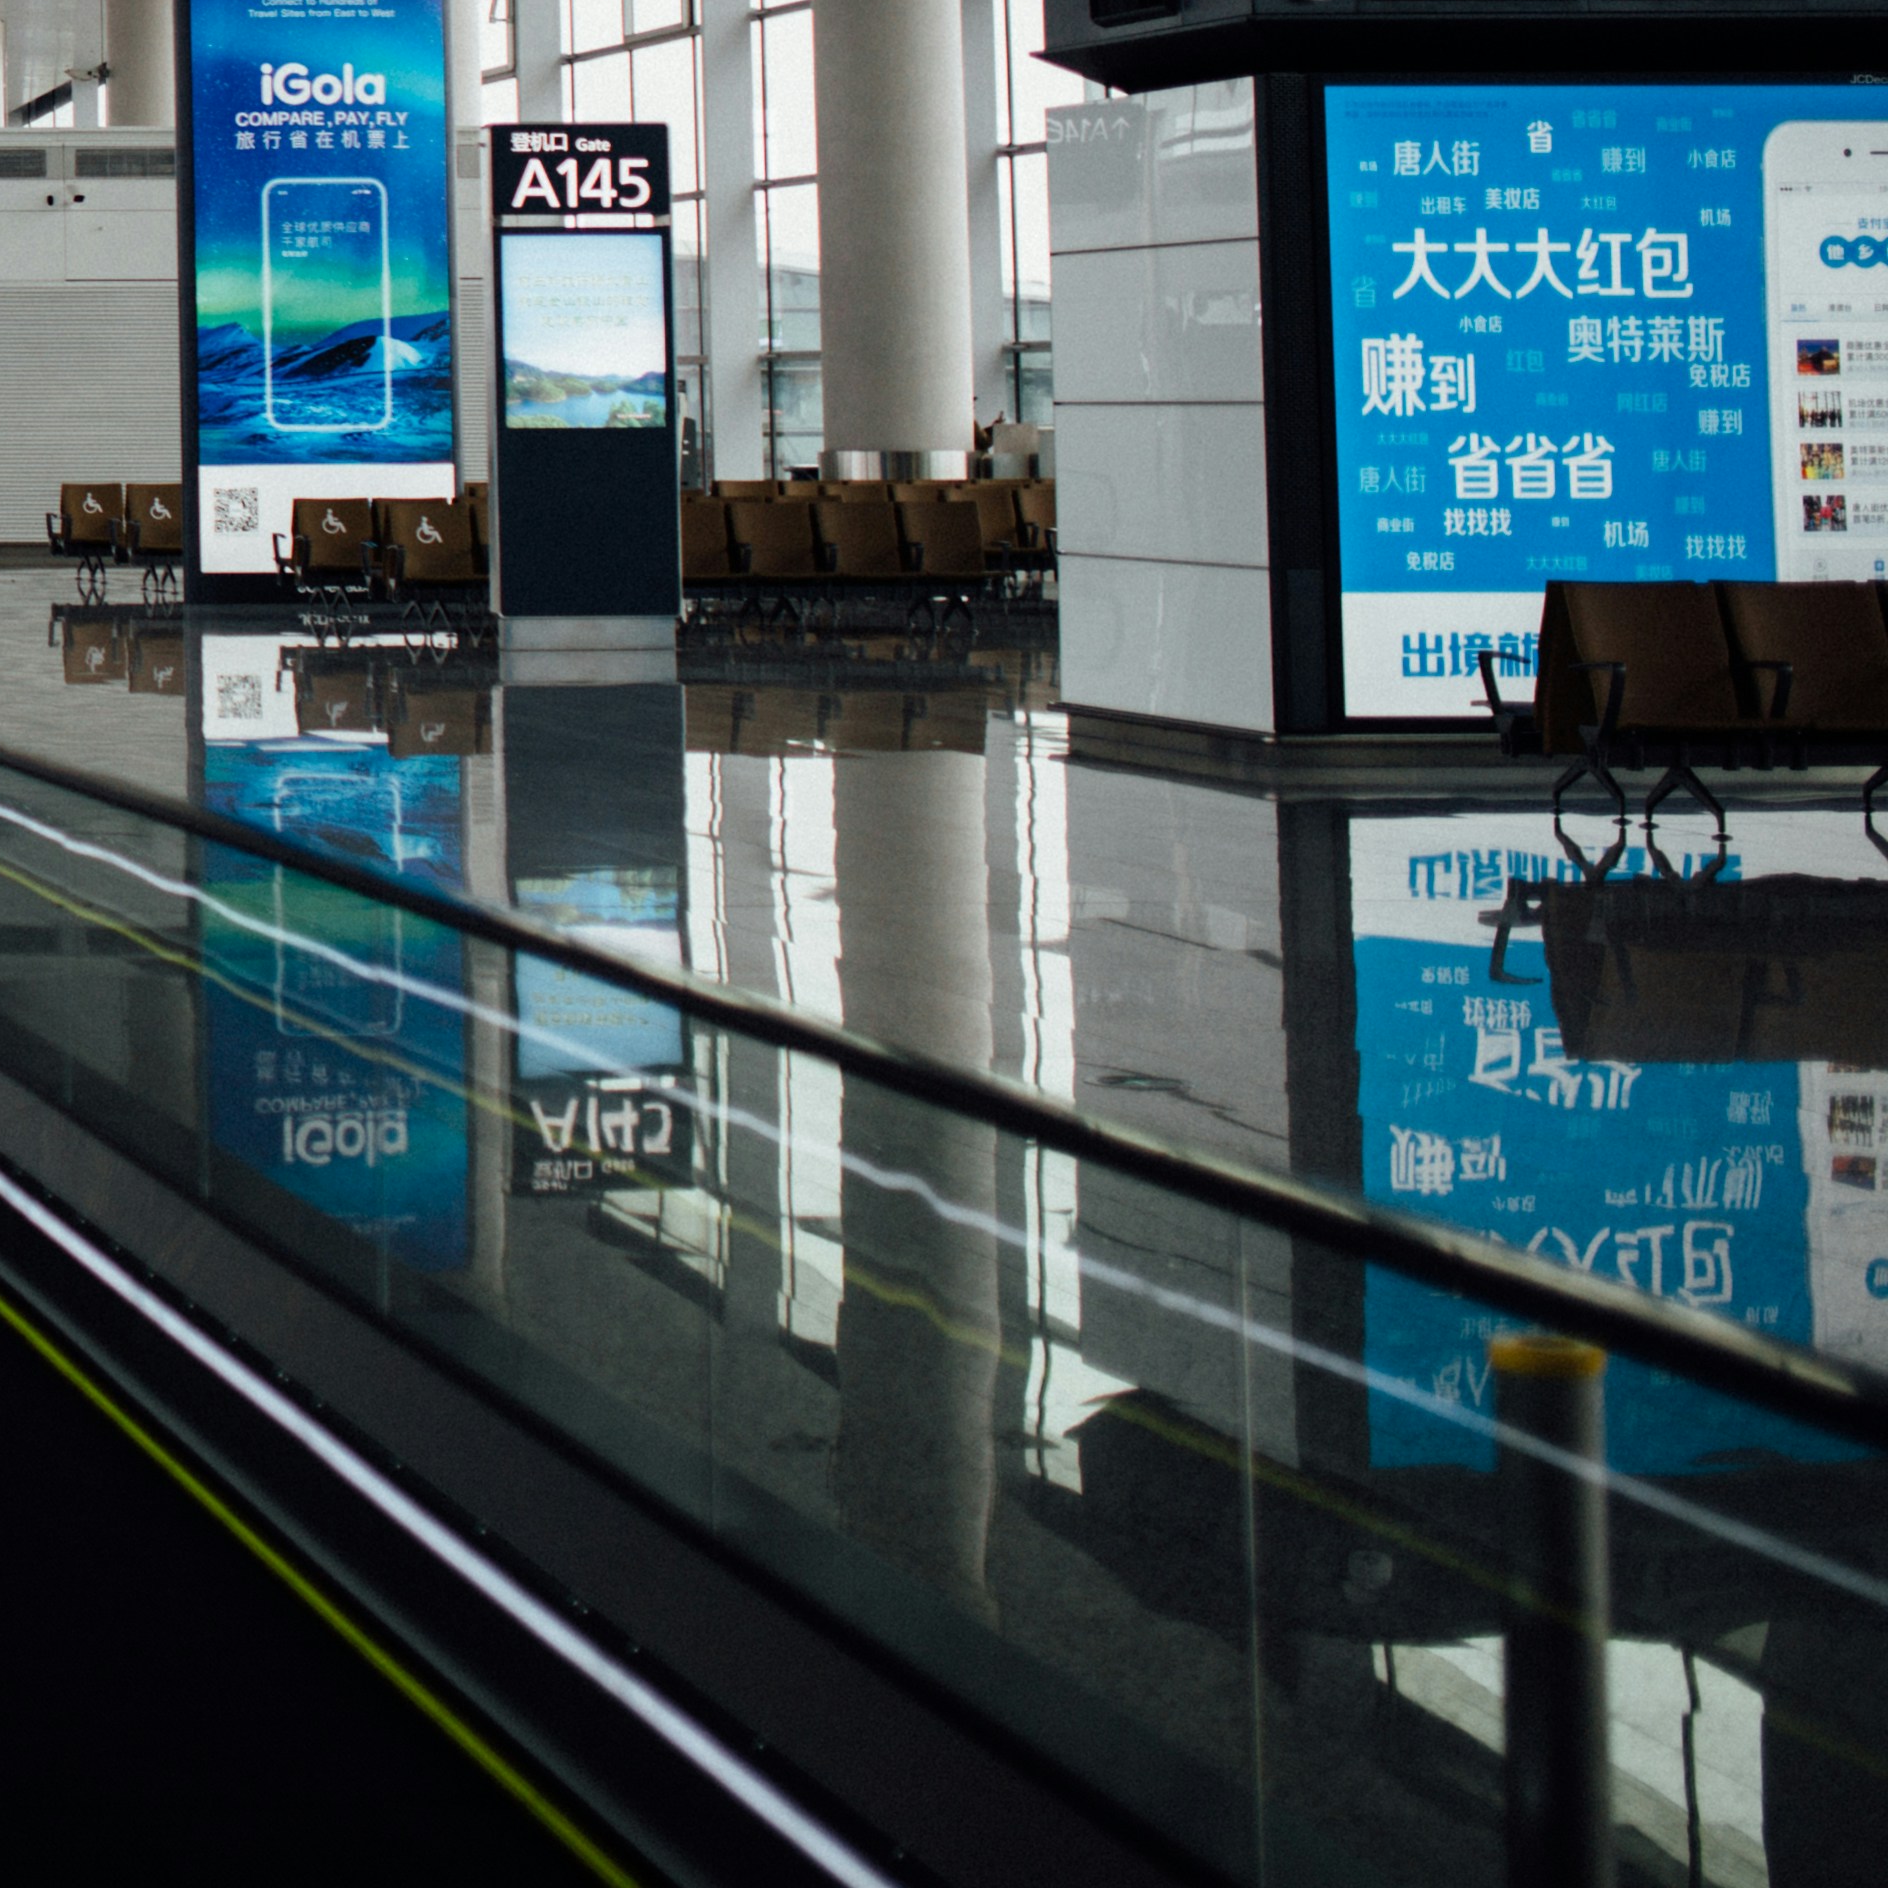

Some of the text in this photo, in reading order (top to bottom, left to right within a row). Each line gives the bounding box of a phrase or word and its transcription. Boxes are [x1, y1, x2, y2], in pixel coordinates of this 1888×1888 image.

[248, 9, 396, 18] Travel Sites from East to West
[260, 62, 385, 105] iGola
[234, 130, 411, 150] 旅行省在机票上
[510, 132, 569, 152] 登机口
[575, 137, 611, 152] Gate
[1527, 120, 1553, 153] 省
[1394, 140, 1480, 176] 唐人街
[1601, 147, 1646, 174] 赚到
[1688, 148, 1736, 168] 小食店
[511, 158, 651, 208] A145
[1421, 197, 1467, 214] 出租车
[1485, 188, 1540, 210] 美妆店
[1581, 196, 1617, 211] 大红包
[1700, 208, 1732, 226] 机场
[1392, 227, 1694, 300] 大大大红包
[1351, 275, 1377, 308] 省
[1460, 315, 1502, 333] 小食店
[1567, 315, 1725, 363] 奥特莱斯
[1506, 349, 1544, 372] 红包
[1361, 333, 1476, 417] 赚到
[1689, 363, 1751, 388] 免税店
[1698, 409, 1742, 435] 赚到
[1448, 432, 1615, 499] 省省省
[1652, 450, 1706, 472] 唐人街
[1359, 466, 1426, 493] 唐人街
[1377, 517, 1414, 532] 商业街
[1444, 508, 1512, 536] 找找找
[1604, 520, 1649, 548] 机场
[1686, 535, 1747, 560] 找找找
[1406, 551, 1455, 571] 免税店
